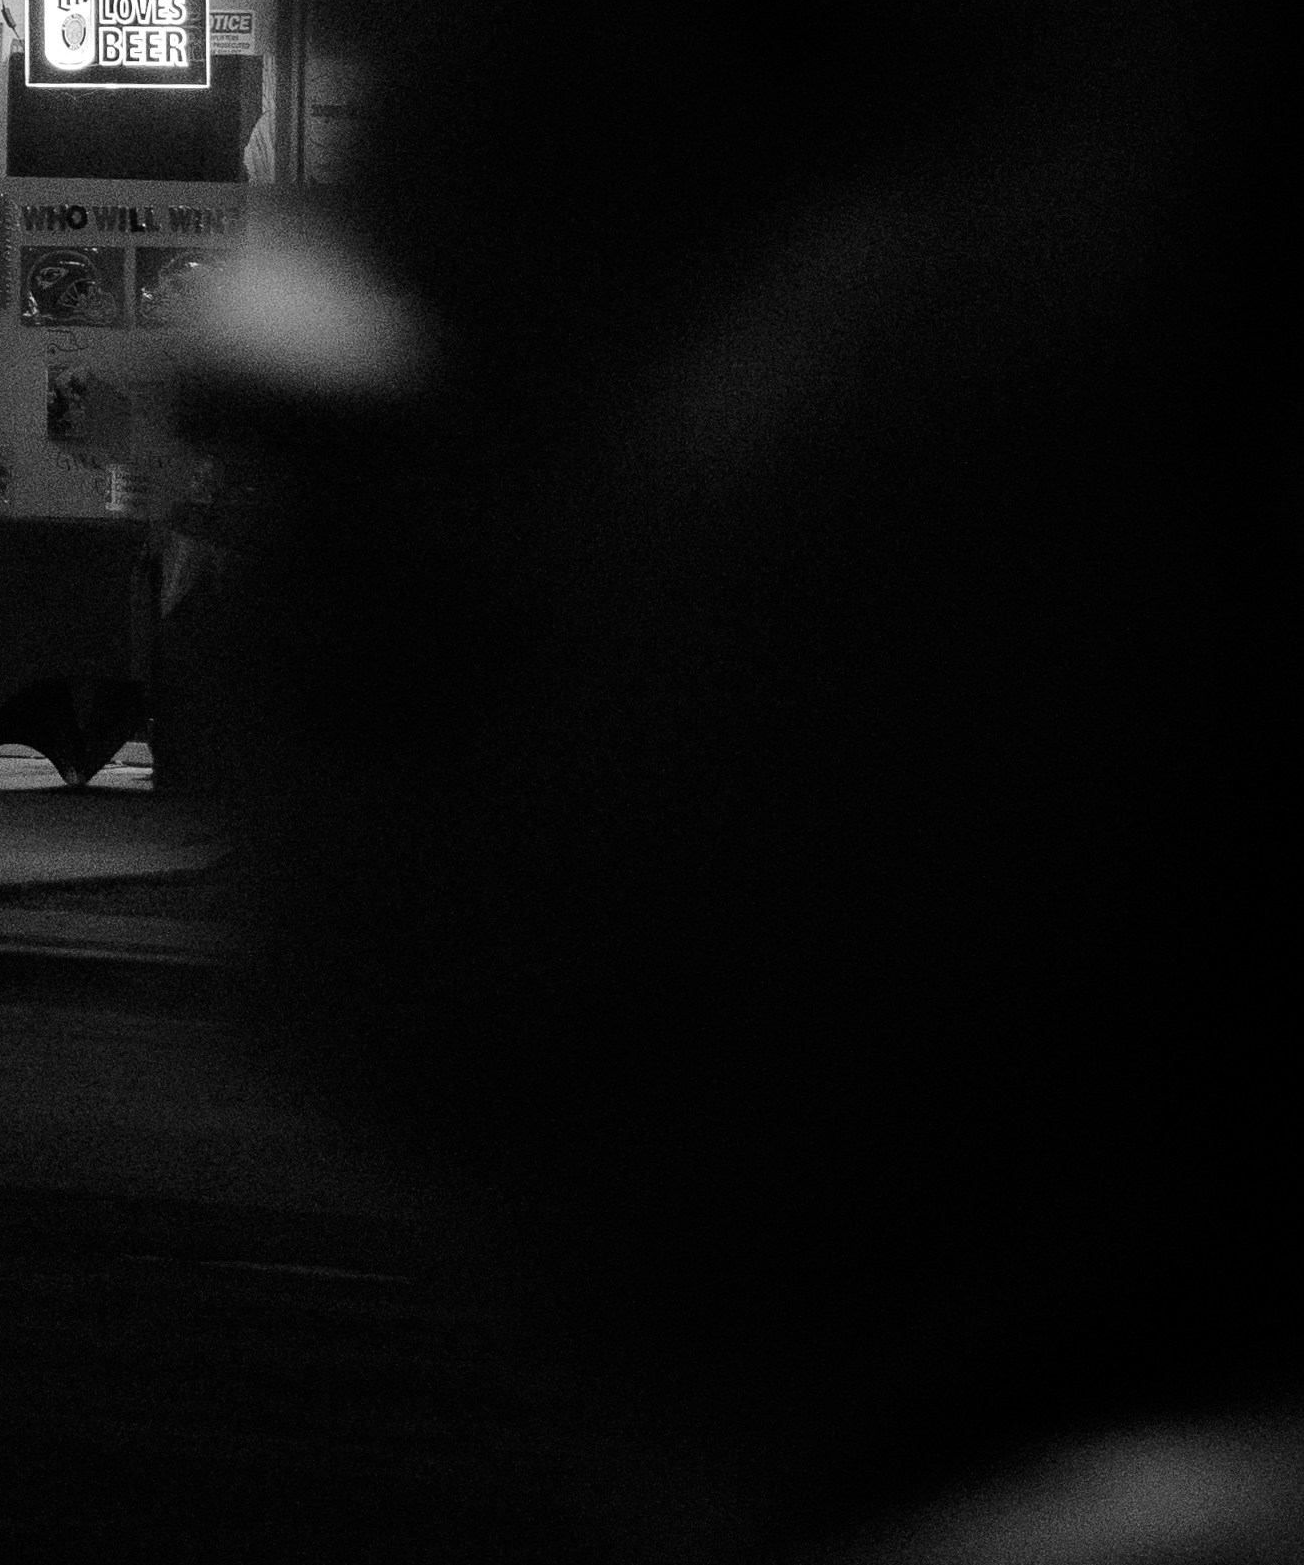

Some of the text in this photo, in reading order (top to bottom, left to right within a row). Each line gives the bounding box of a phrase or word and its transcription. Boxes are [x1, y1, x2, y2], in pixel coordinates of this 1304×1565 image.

[99, 26, 188, 67] BEER
[20, 205, 88, 232] WHO
[92, 205, 160, 233] WILL
